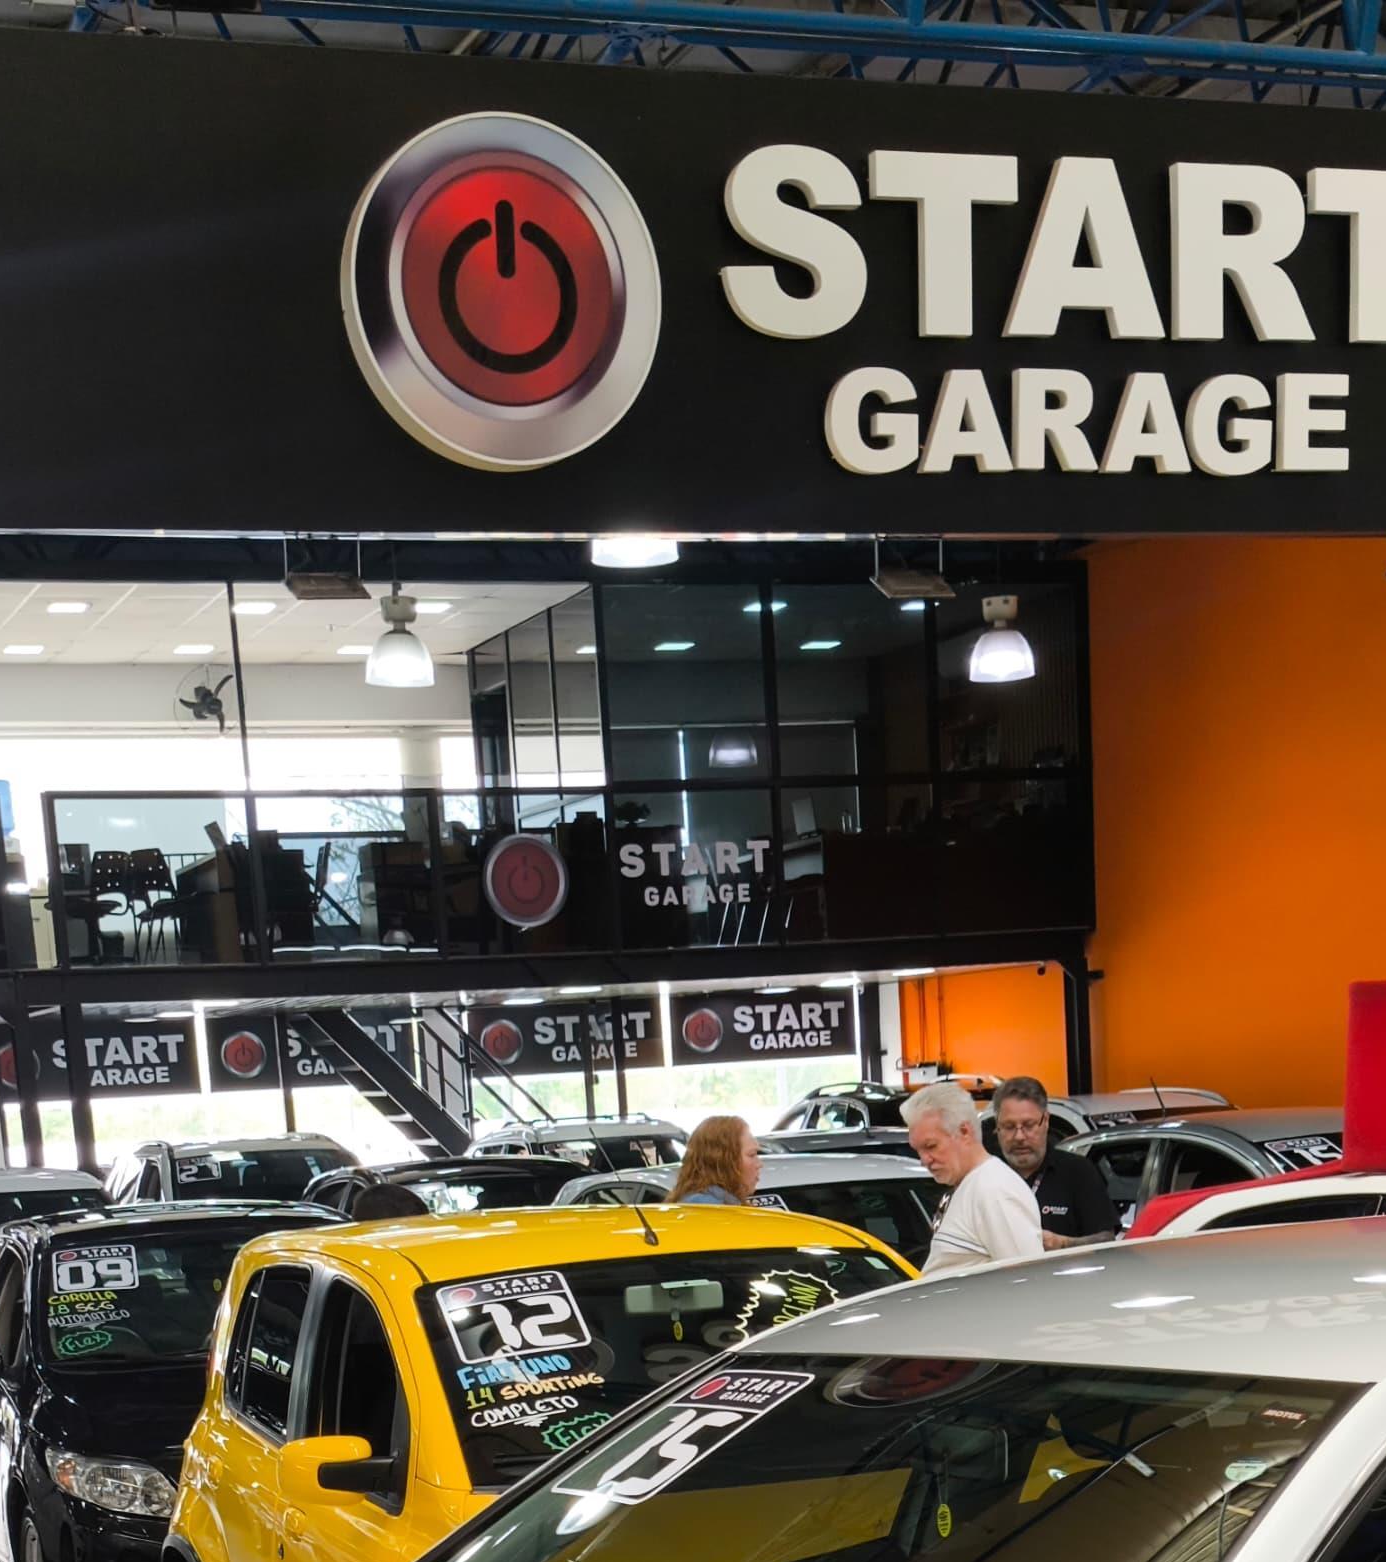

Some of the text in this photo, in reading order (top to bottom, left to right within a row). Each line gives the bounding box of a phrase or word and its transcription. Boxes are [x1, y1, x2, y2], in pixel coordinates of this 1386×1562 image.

[826, 367, 1350, 475] GARAGE
[620, 840, 769, 879] START
[644, 883, 751, 907] GARAGE
[732, 1001, 845, 1033] START
[750, 1028, 832, 1050] GARAGE
[91, 1066, 170, 1086] ARAGE
[58, 1259, 134, 1290] 09
[481, 1275, 554, 1292] START
[48, 1291, 117, 1304] COROLLA
[494, 1284, 549, 1296] GARAGE
[482, 1295, 578, 1349] 12
[520, 1354, 571, 1375] UNO
[727, 1378, 799, 1394] START
[719, 1392, 770, 1403] GARAGE
[471, 1395, 578, 1426] COMPLETO
